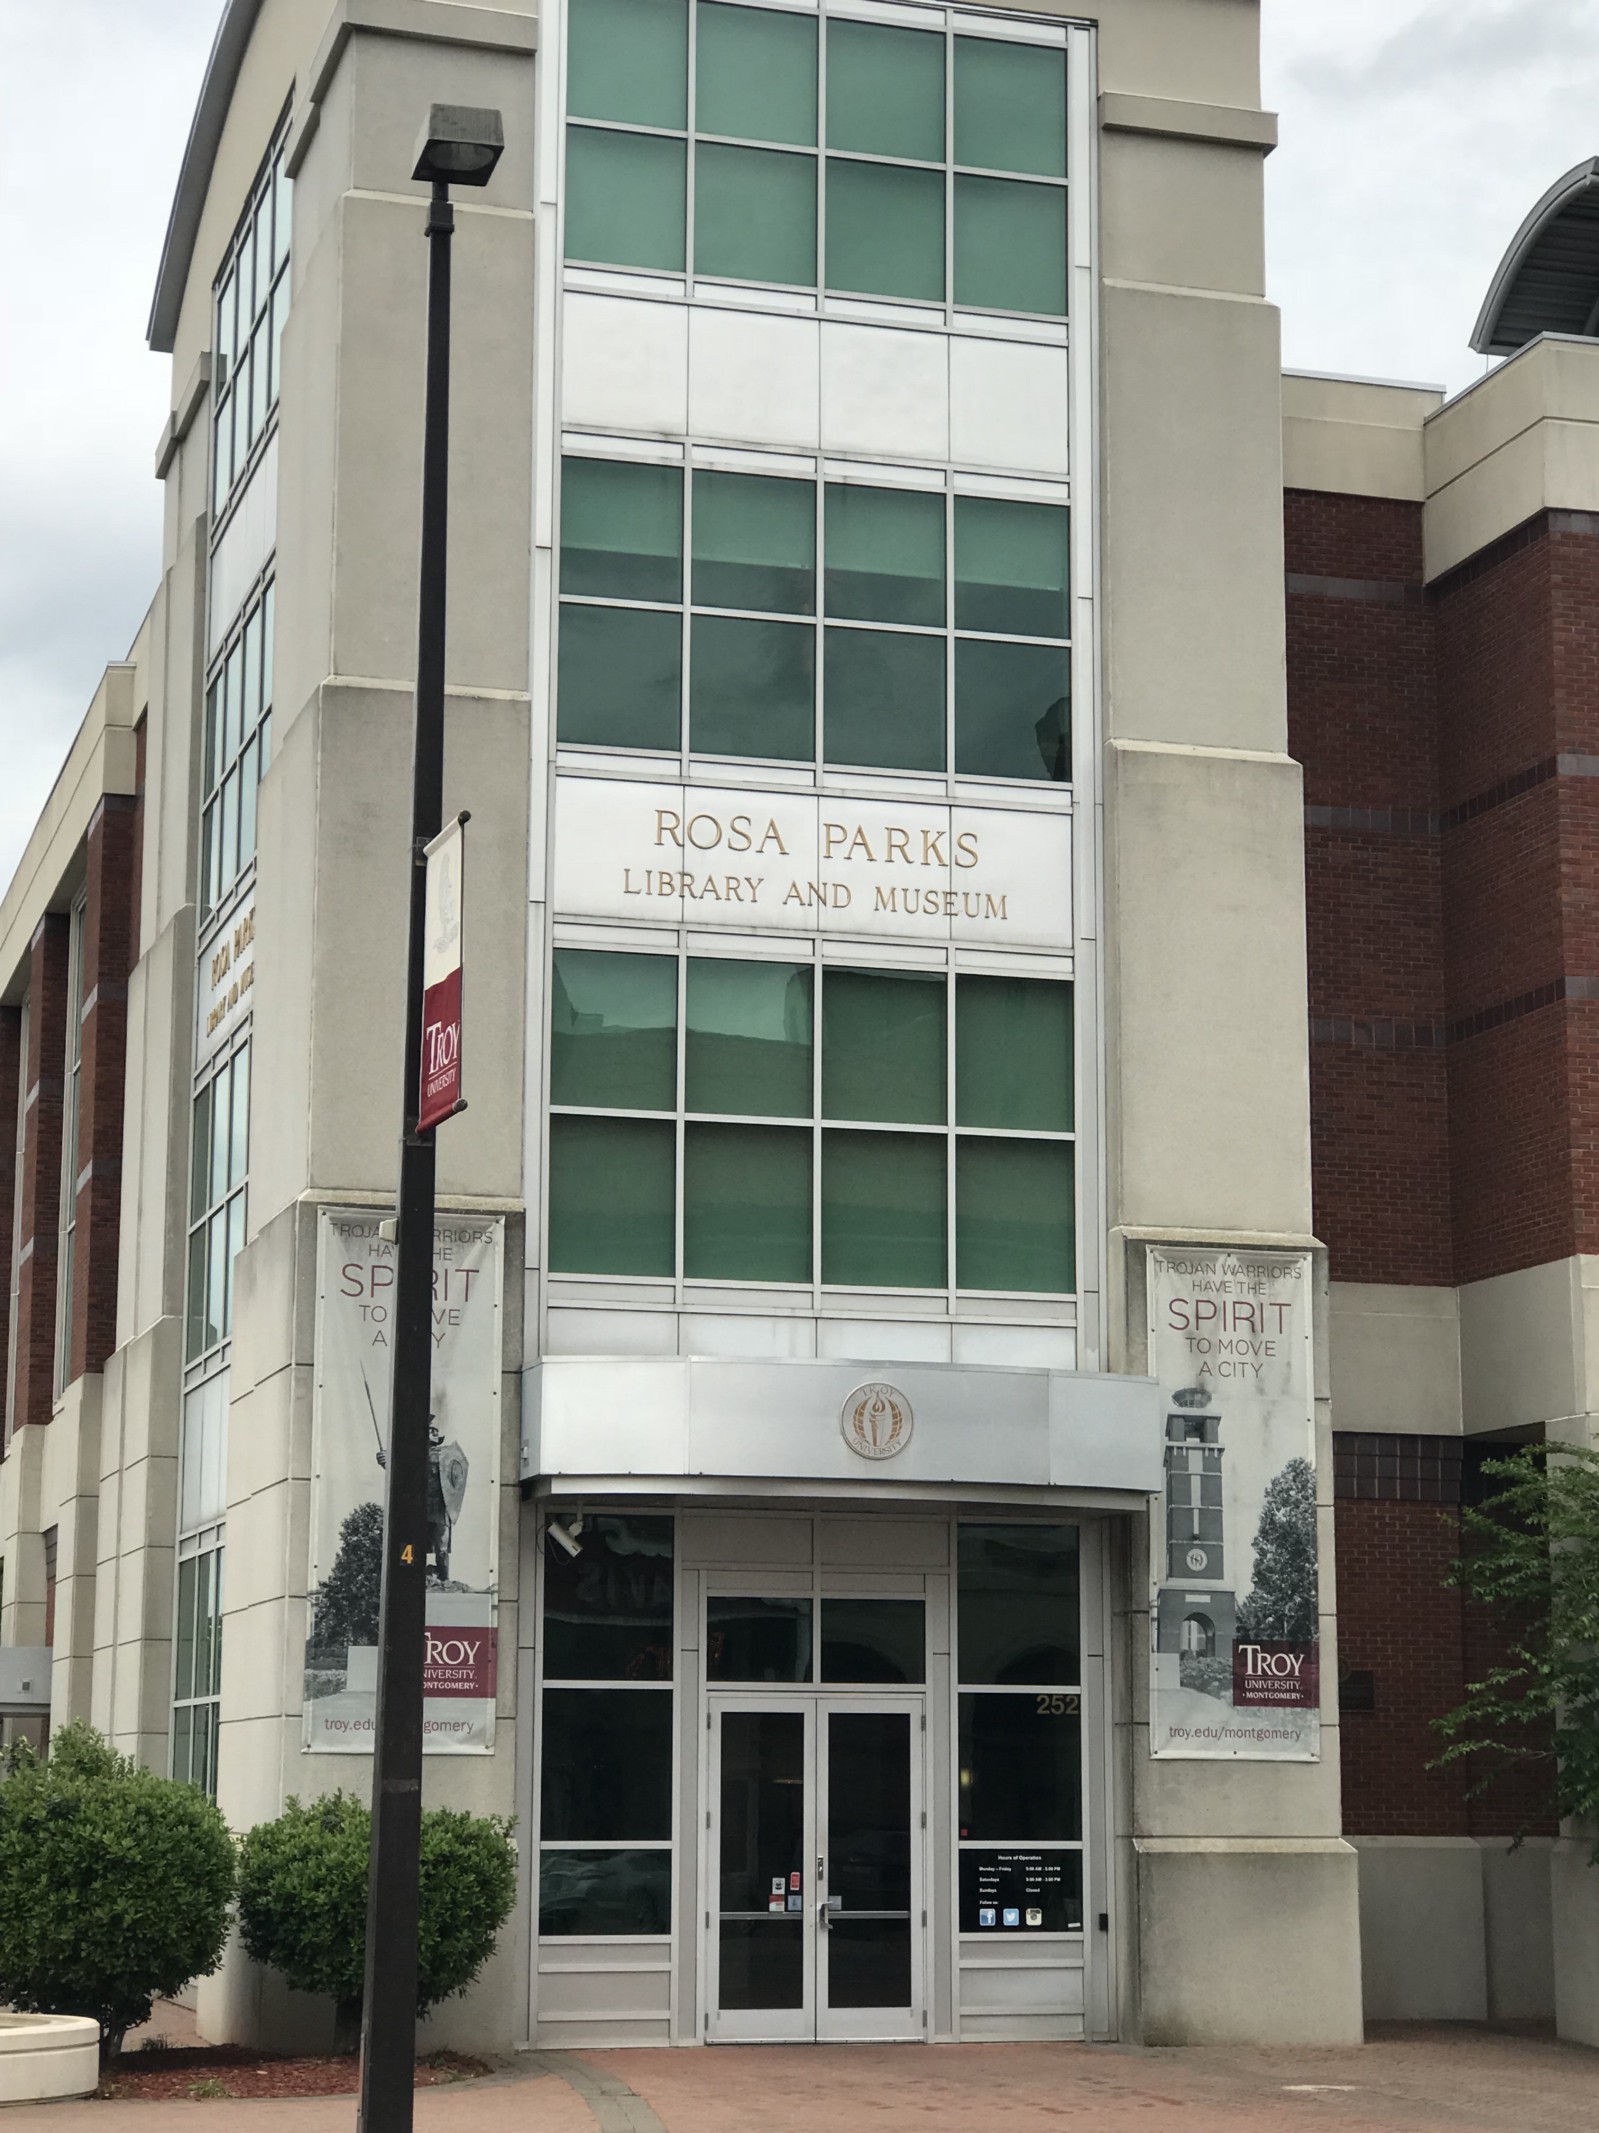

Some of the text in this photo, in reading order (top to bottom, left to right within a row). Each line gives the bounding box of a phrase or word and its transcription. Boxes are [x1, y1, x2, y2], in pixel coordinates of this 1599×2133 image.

[654, 808, 979, 869] ROSA PARKS
[623, 867, 1010, 921] LIBRARY AND MUSEUM
[426, 1021, 460, 1075] TROY
[427, 1068, 457, 1098] UNIVERSITY
[329, 1222, 493, 1245] TROJA RRIORS
[432, 1247, 453, 1261] HE
[1156, 1260, 1302, 1280] TROJAN WARRIORS
[1192, 1280, 1267, 1295] HAVE THE
[359, 1305, 461, 1326] TO VE
[1168, 1298, 1292, 1335] SPIRIT
[372, 1330, 388, 1347] A
[1186, 1337, 1276, 1357] TO MOVE
[1199, 1361, 1264, 1378] A CITY
[862, 1386, 898, 1397] TROY
[852, 1437, 903, 1456] UNIVERSITY
[400, 1544, 414, 1564] 4
[424, 1632, 482, 1665] ROY
[1238, 1644, 1305, 1677] TROY
[423, 1669, 475, 1680] NIVERSITY
[422, 1681, 474, 1690] NTGOMERY
[1245, 1680, 1301, 1690] UNIVERSITY
[1036, 1694, 1079, 1716] 252
[1168, 1725, 1302, 1742] troy.edu/montgomery
